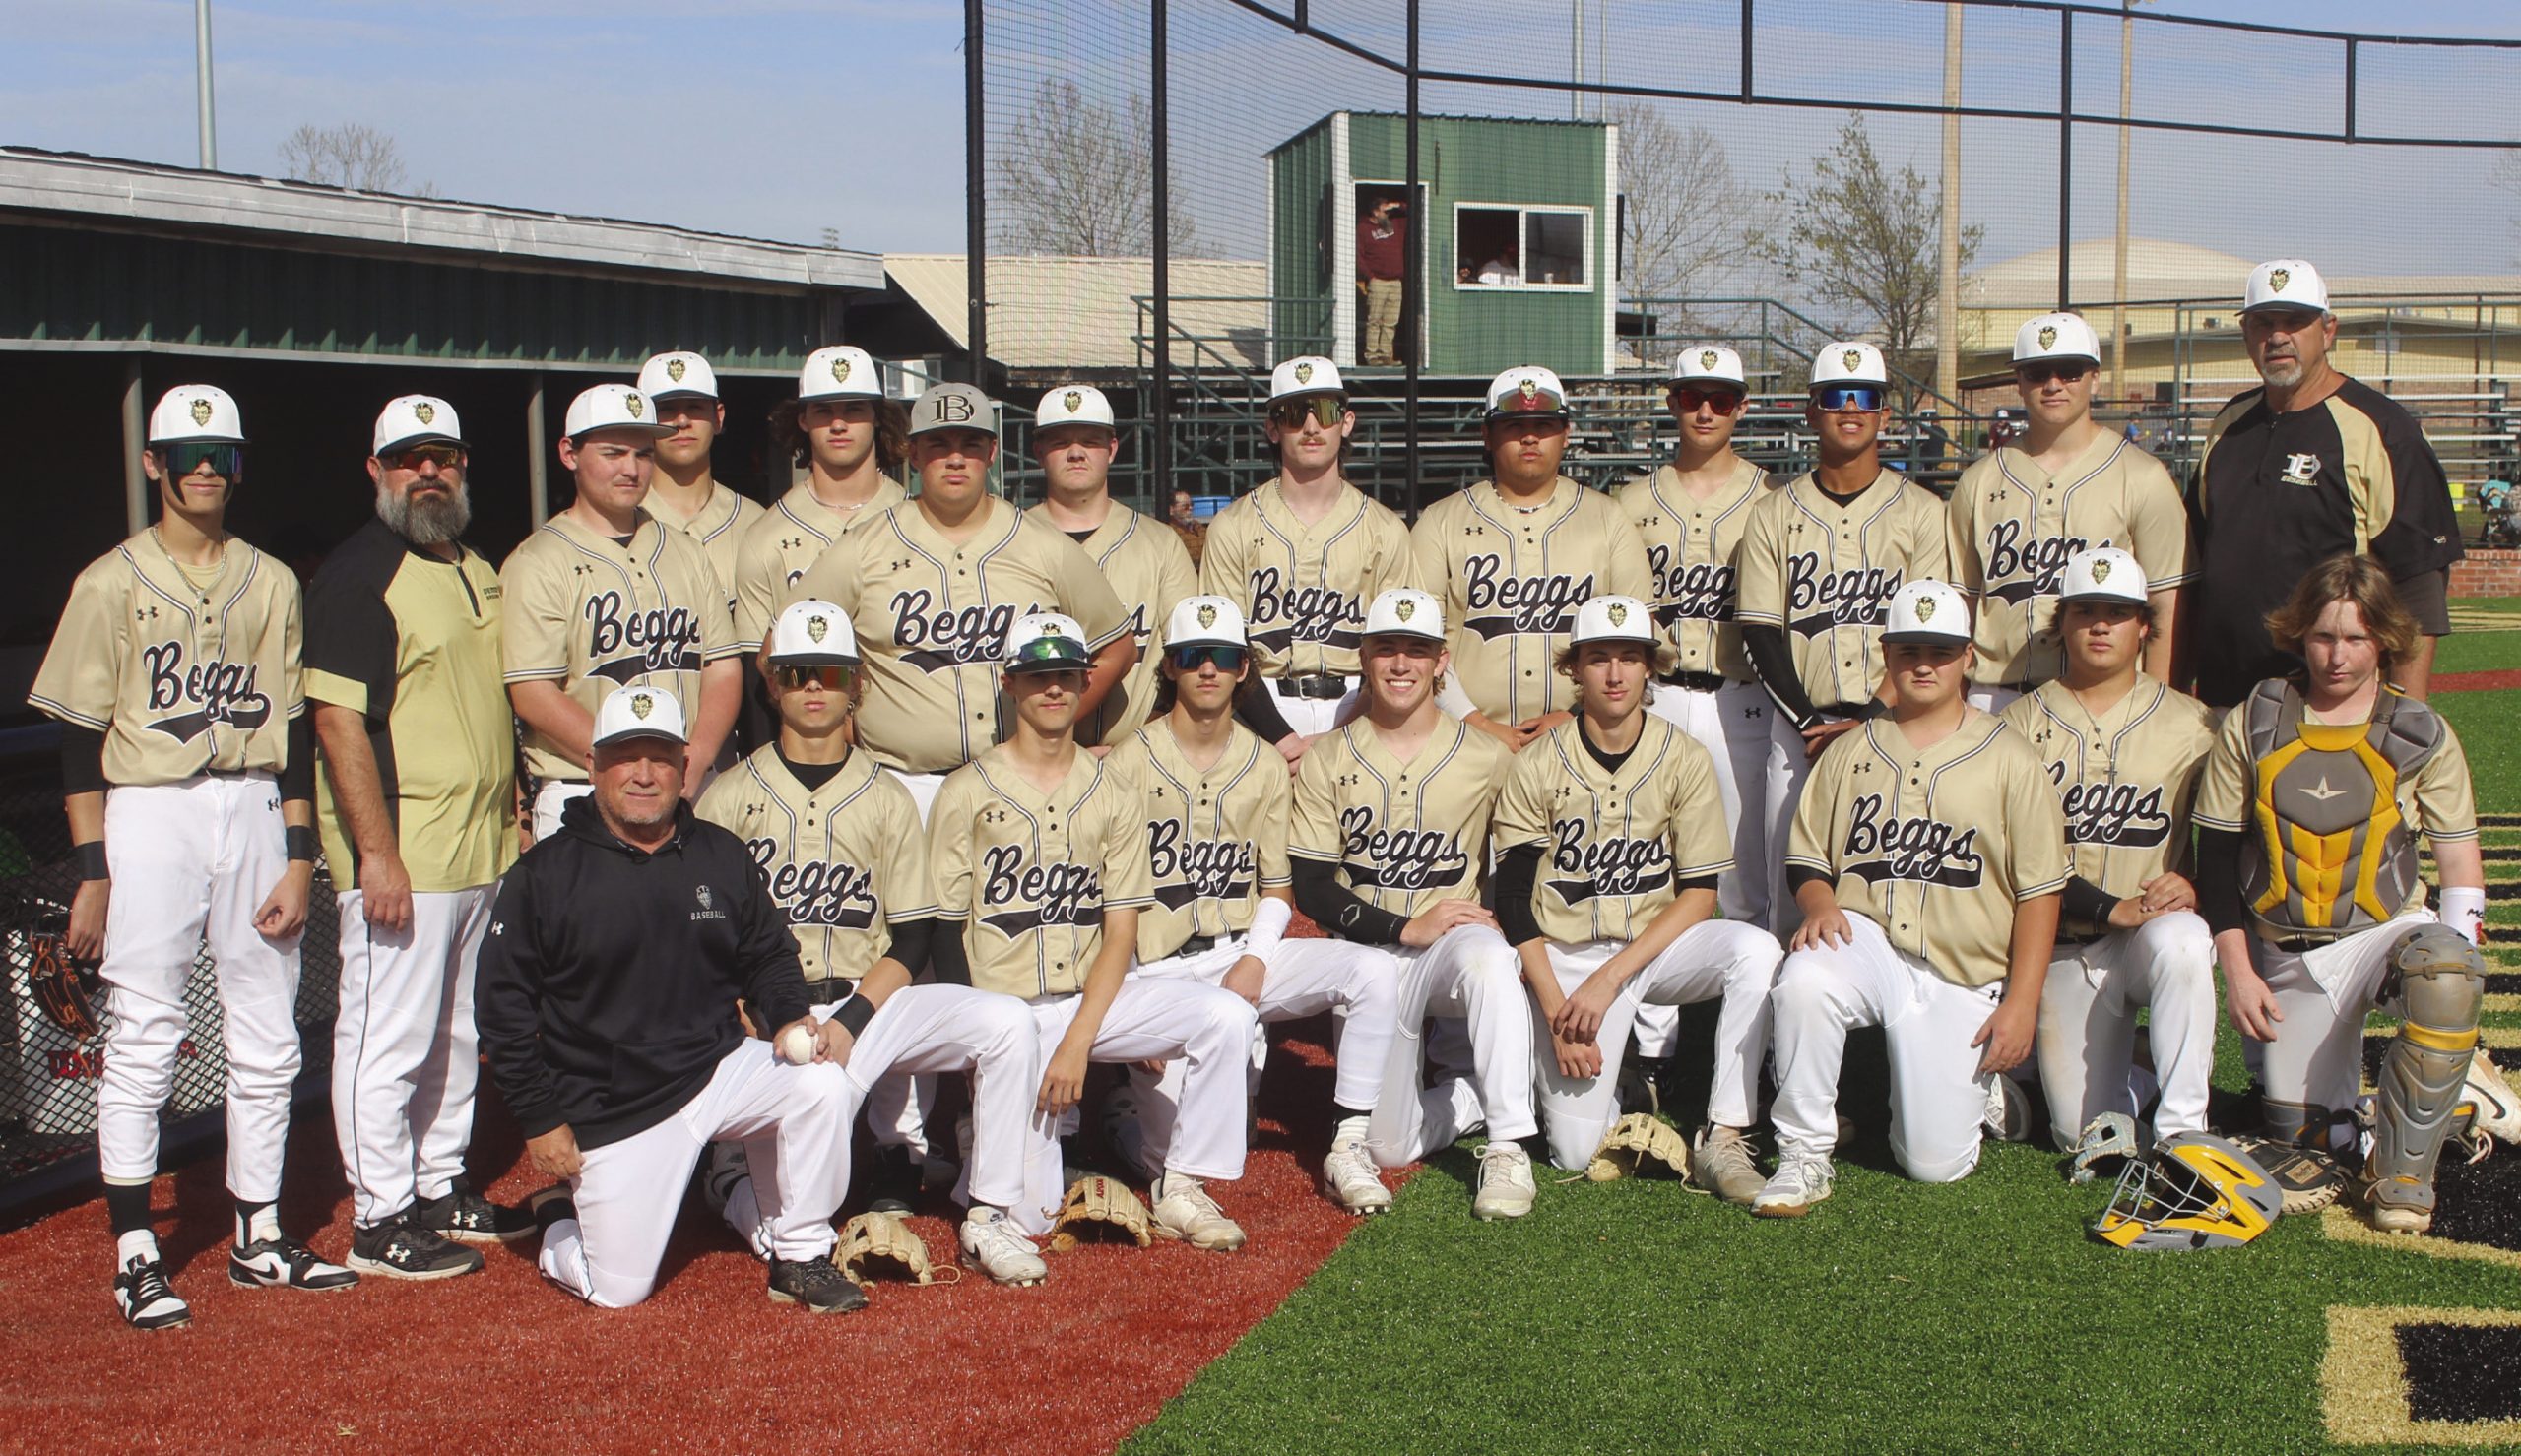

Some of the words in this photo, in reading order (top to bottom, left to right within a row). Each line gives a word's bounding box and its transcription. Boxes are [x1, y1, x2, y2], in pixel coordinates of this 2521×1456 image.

[1462, 552, 1595, 632] Beggs
[1646, 543, 1737, 618] Begg
[1787, 550, 1903, 624] Beggs
[1986, 517, 2110, 594] Beg
[889, 588, 1041, 663] Begg
[1249, 566, 1366, 643] Beggs
[1147, 816, 1256, 897] Beggs
[1340, 804, 1464, 888] Beggs
[1553, 817, 1672, 894] Beggs
[1843, 792, 1978, 880] Beggs
[690, 910, 727, 921] BASEBALL
[983, 843, 1103, 923] Beggs
